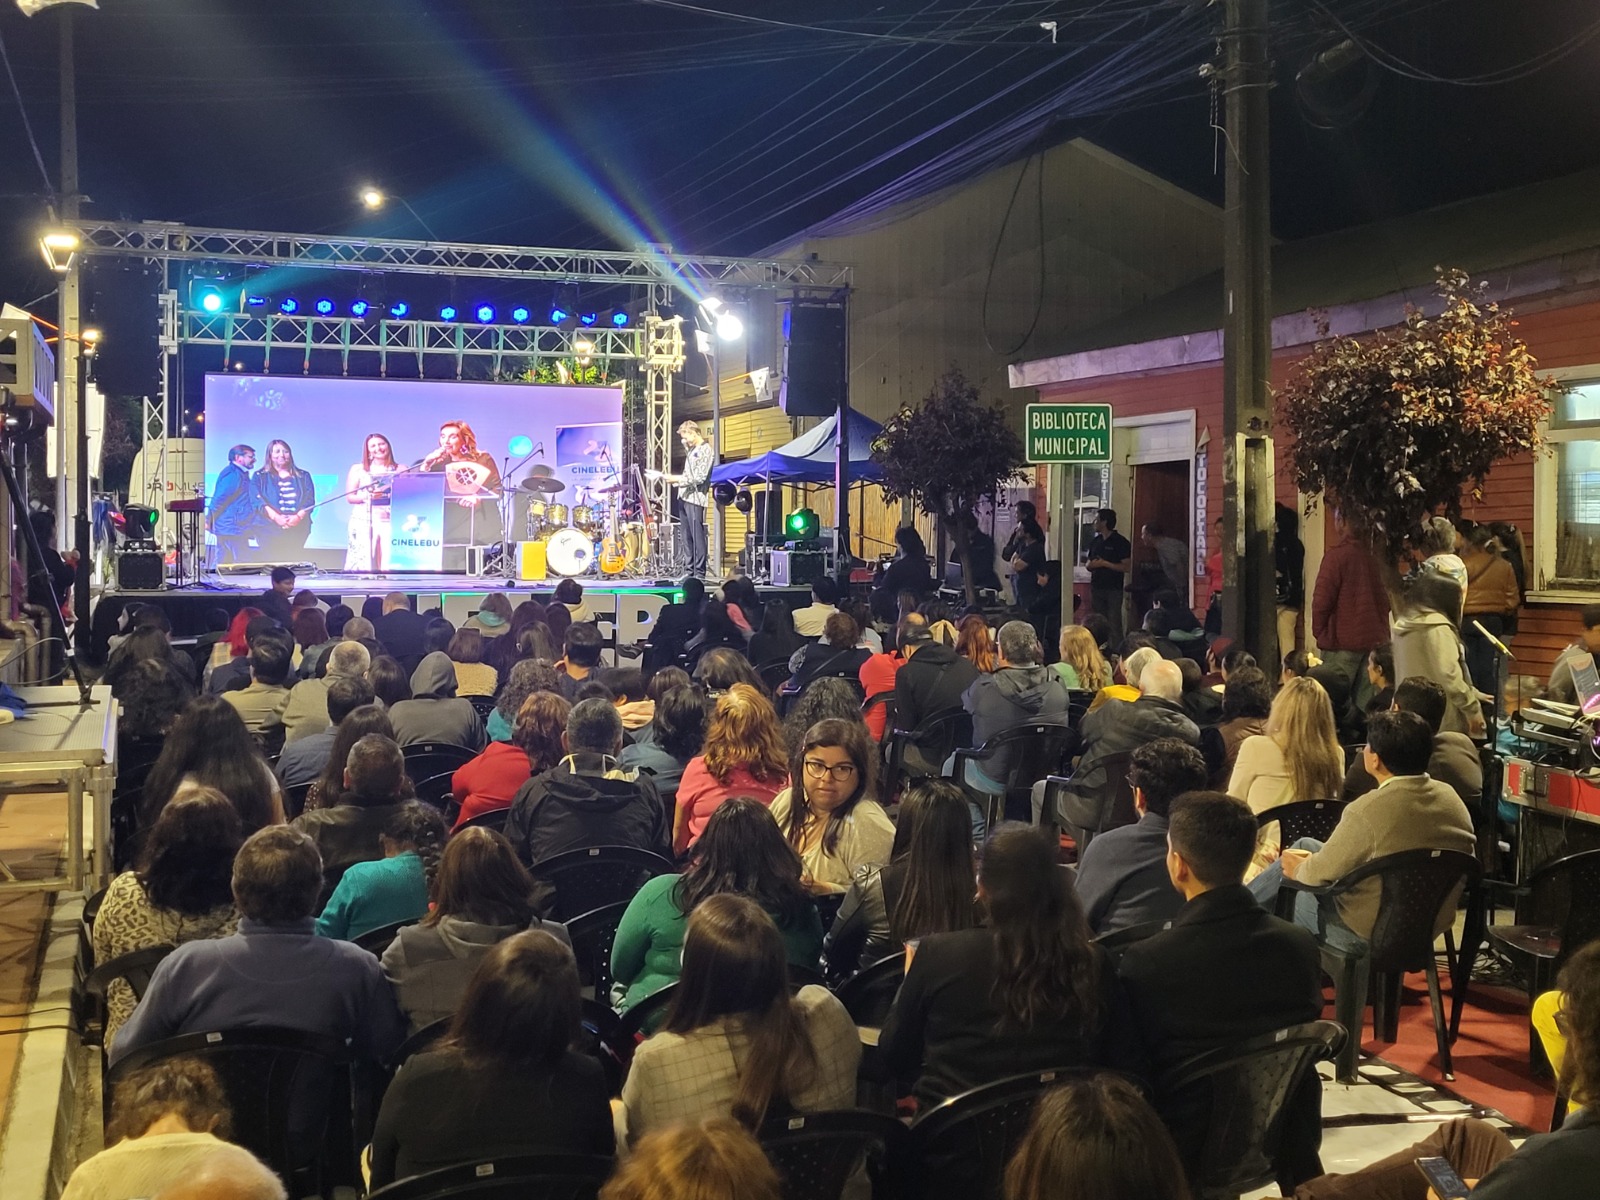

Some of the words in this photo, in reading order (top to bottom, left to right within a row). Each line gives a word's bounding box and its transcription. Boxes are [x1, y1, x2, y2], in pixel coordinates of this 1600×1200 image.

[1032, 412, 1106, 430] BIBLIOTECA
[1034, 437, 1105, 455] MUNICIPAL
[571, 466, 620, 474] CINELEBU
[391, 538, 440, 547] CINELEBU
